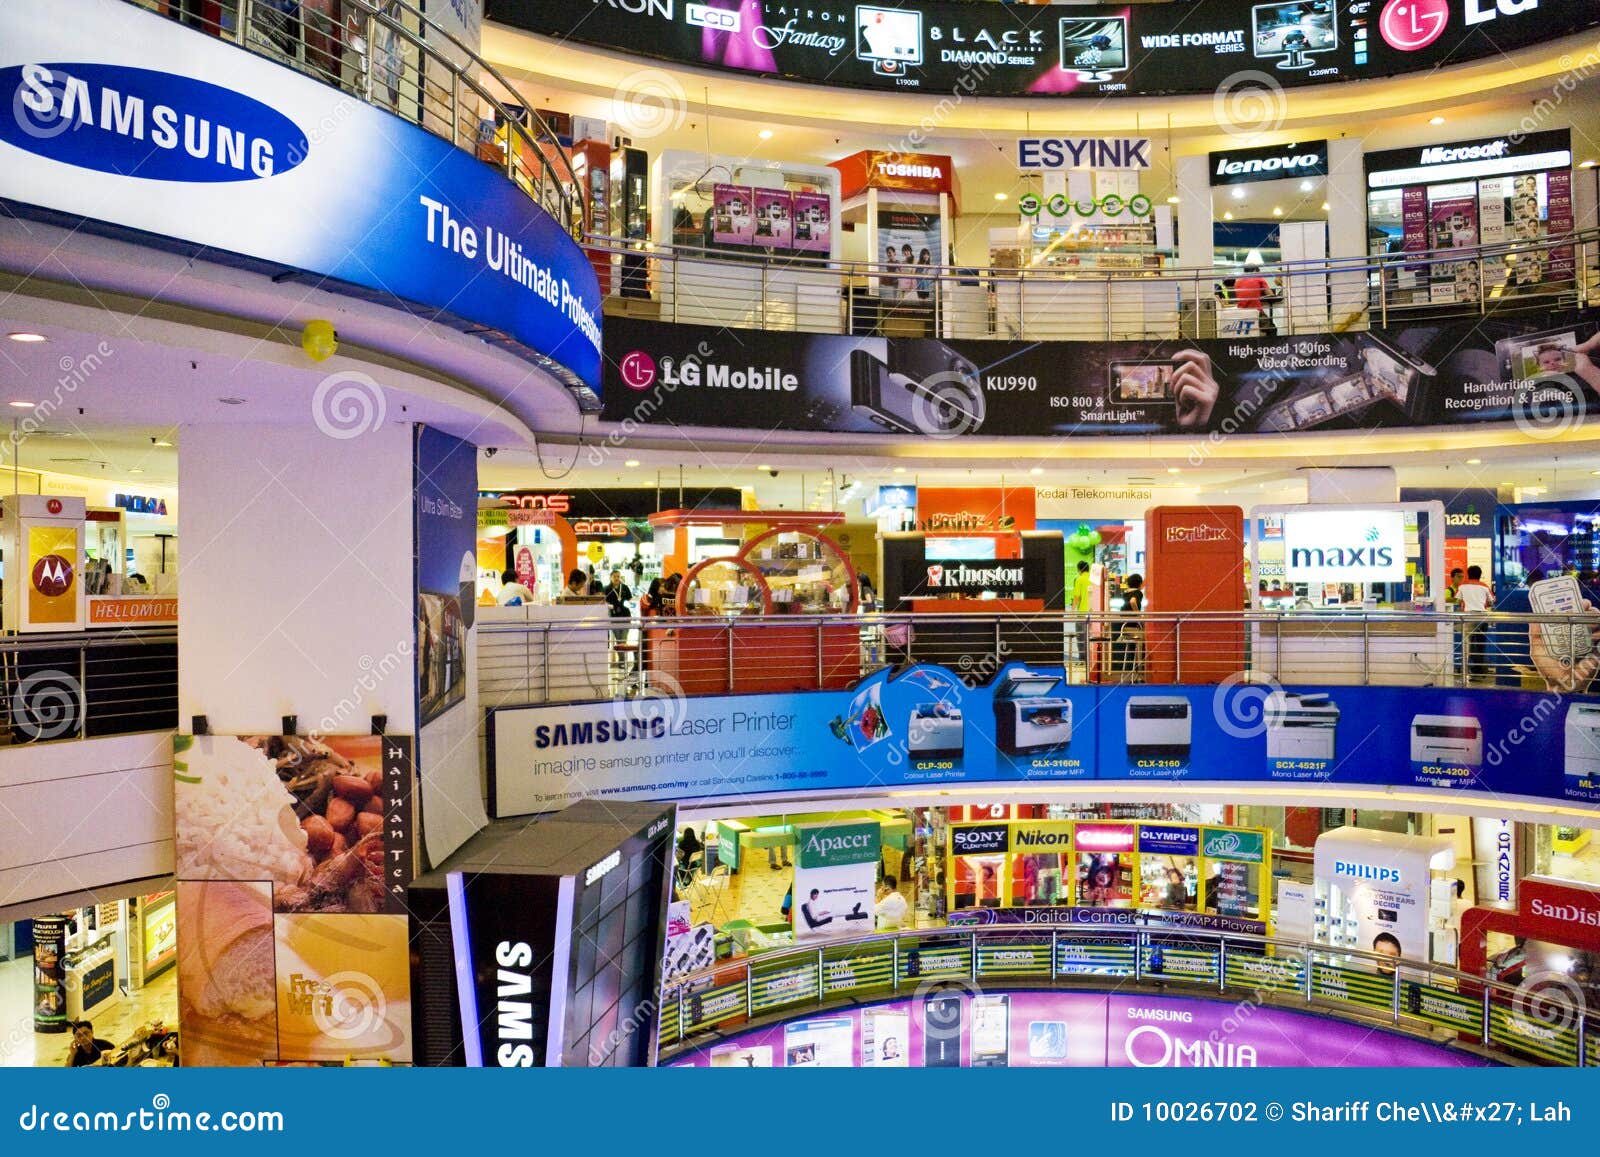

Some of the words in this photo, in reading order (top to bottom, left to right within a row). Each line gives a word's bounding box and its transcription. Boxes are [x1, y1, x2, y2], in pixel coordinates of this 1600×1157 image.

[691, 8, 736, 27] LCD
[751, 3, 846, 23] FLATRON
[752, 19, 846, 56] Fantasy
[930, 26, 1043, 51] BLACK
[1140, 35, 1180, 48] WIDE
[1183, 30, 1245, 46] FORMAT
[941, 49, 1007, 64] DIAMOND
[1008, 56, 1036, 65] SERIES
[1214, 43, 1245, 54] SERIES
[20, 63, 275, 179] SAMSUNG
[1019, 139, 1149, 168] ESYINK
[1420, 140, 1508, 165] Microsoft
[877, 163, 942, 179] TOSHIBA
[1216, 153, 1319, 176] lenovo
[420, 195, 478, 259] The
[486, 226, 559, 308] Ultimate
[1228, 343, 1289, 358] High-speed
[1292, 342, 1331, 355] 120fps
[1257, 355, 1288, 369] Video
[1290, 354, 1347, 369] Recording
[662, 361, 700, 387] LG
[707, 364, 799, 391] Mobile
[986, 376, 1037, 391] KU990
[1464, 379, 1536, 395] Handwriting
[1050, 397, 1069, 408] ISO
[1072, 397, 1092, 408] 800
[1095, 397, 1105, 408] &
[1445, 395, 1515, 410] Recognition
[1518, 393, 1529, 404] &
[1532, 389, 1574, 405] Editing
[1037, 489, 1068, 500] Kedai
[1071, 488, 1153, 500] Telekomunikasi
[1292, 546, 1393, 568] maxis
[944, 564, 1024, 587] Kingston
[95, 603, 178, 618] HELLOMOTO
[535, 716, 666, 749] SAMSUNG
[669, 714, 724, 737] Laser
[731, 711, 796, 733] Printer
[534, 756, 597, 777] imagine
[600, 755, 651, 770] samsung
[655, 752, 689, 767] printer
[693, 749, 715, 761] and
[718, 748, 746, 762] you'll
[916, 762, 953, 770] CLP-300
[1137, 759, 1181, 769] CLX-2160
[1275, 760, 1327, 771] SCX-4521F
[1422, 765, 1470, 777] SCX-4200
[1129, 769, 1151, 777] Colour
[387, 747, 404, 839] Hainan
[600, 780, 689, 796] www.samsung.com/my
[805, 833, 873, 857] Apacer
[954, 830, 1007, 844] SONY
[1016, 830, 1069, 846] Nikon
[1140, 831, 1198, 842] OLYMPUS
[389, 849, 405, 894] Tea
[1335, 861, 1400, 883] PHILIPS
[1373, 899, 1401, 909] DECIDE
[1024, 910, 1073, 924] Digital
[1077, 909, 1144, 924] Camera
[1161, 914, 1218, 928] MP3/MP4
[1220, 919, 1260, 933] Player
[289, 973, 332, 994] Free
[1127, 1007, 1193, 1023] SAMSUNG
[1125, 1025, 1257, 1067] OMNIA
